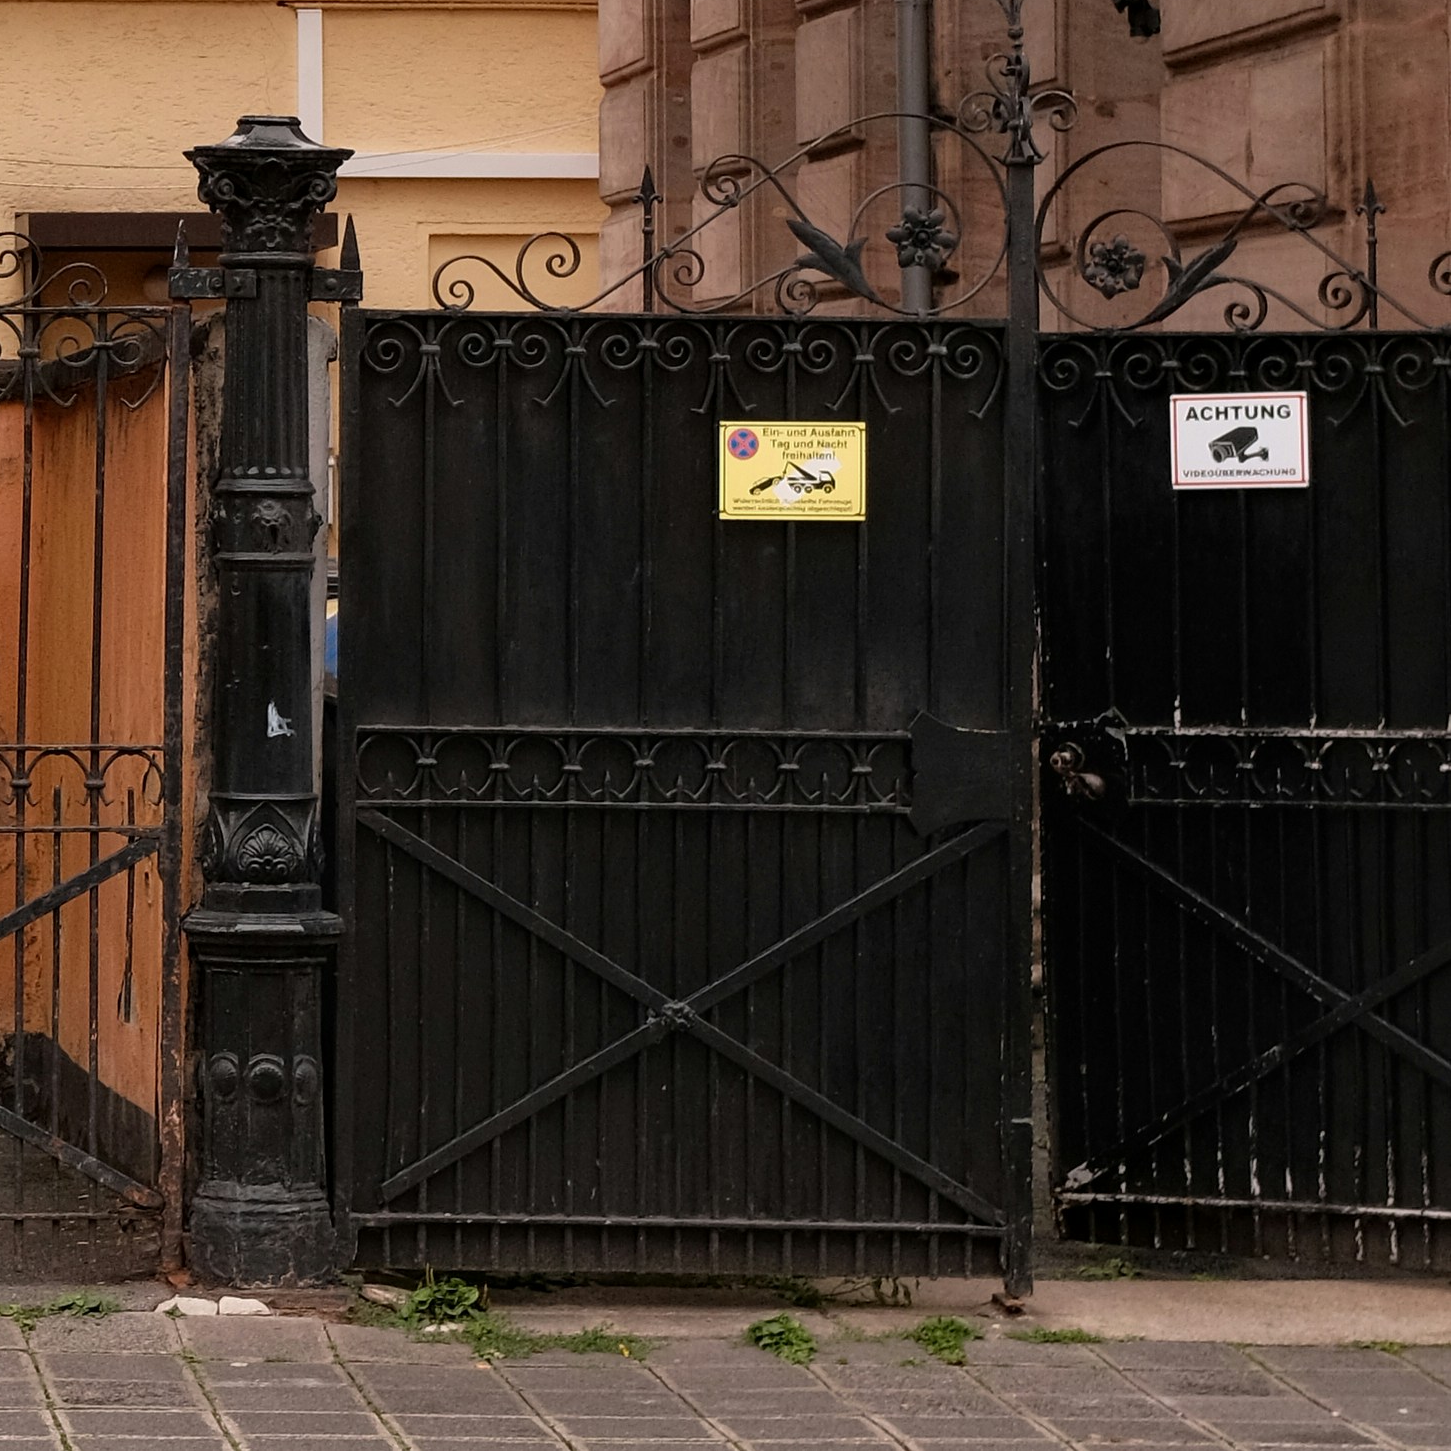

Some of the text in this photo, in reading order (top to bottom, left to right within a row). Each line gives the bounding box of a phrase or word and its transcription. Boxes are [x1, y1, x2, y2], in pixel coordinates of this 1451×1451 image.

[1185, 404, 1291, 421] ACHTUNG
[762, 427, 856, 437] Ein- und Ausfahrt
[770, 439, 848, 450] Tag und Nacht
